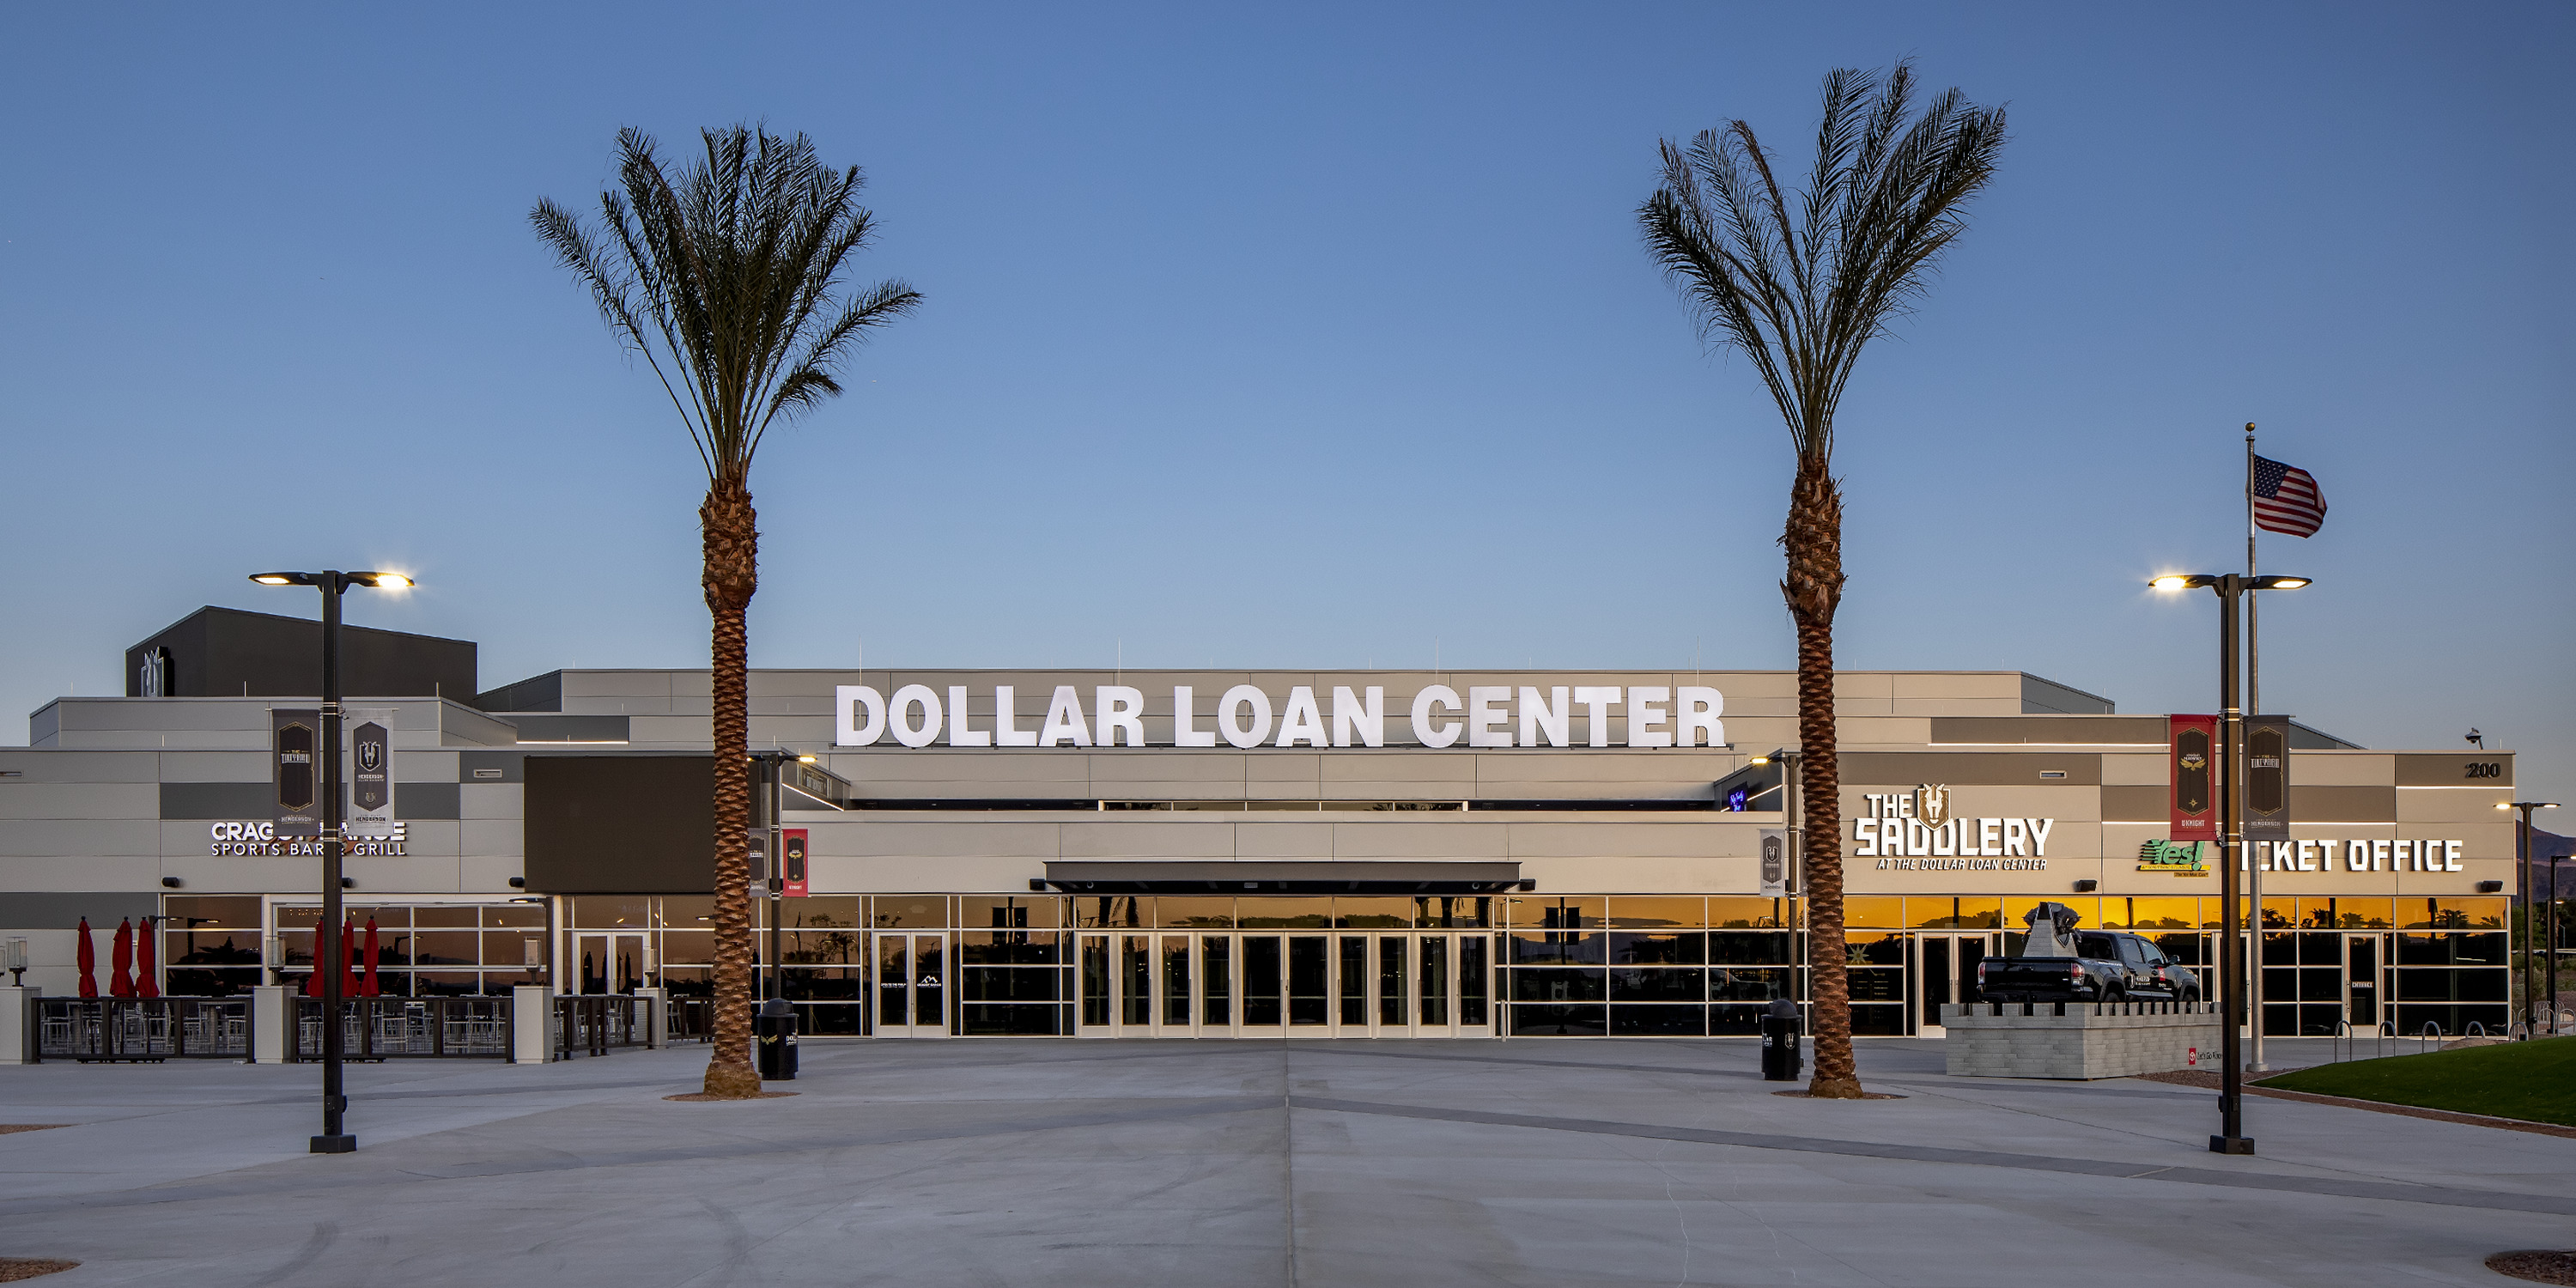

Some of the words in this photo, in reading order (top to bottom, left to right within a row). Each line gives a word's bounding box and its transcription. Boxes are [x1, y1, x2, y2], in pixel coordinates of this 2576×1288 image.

[835, 684, 1145, 747] DOLLAR
[1176, 685, 1384, 748] LOAN
[1411, 684, 1727, 748] CENTER
[2465, 762, 2500, 778] 200
[1867, 794, 1913, 818] THE
[212, 843, 281, 856] SPORTS
[290, 843, 324, 855] BAR
[354, 843, 405, 855] GRILL
[1856, 817, 2055, 856] SADDLERY
[1878, 859, 1892, 871] AT
[1897, 859, 1917, 871] THE
[1921, 859, 1965, 871] DOLLAR
[1970, 859, 1999, 871] LOAN
[2004, 859, 2047, 871] CENTER
[2142, 839, 2205, 871] Yes!
[2348, 840, 2464, 872] OFFICE
